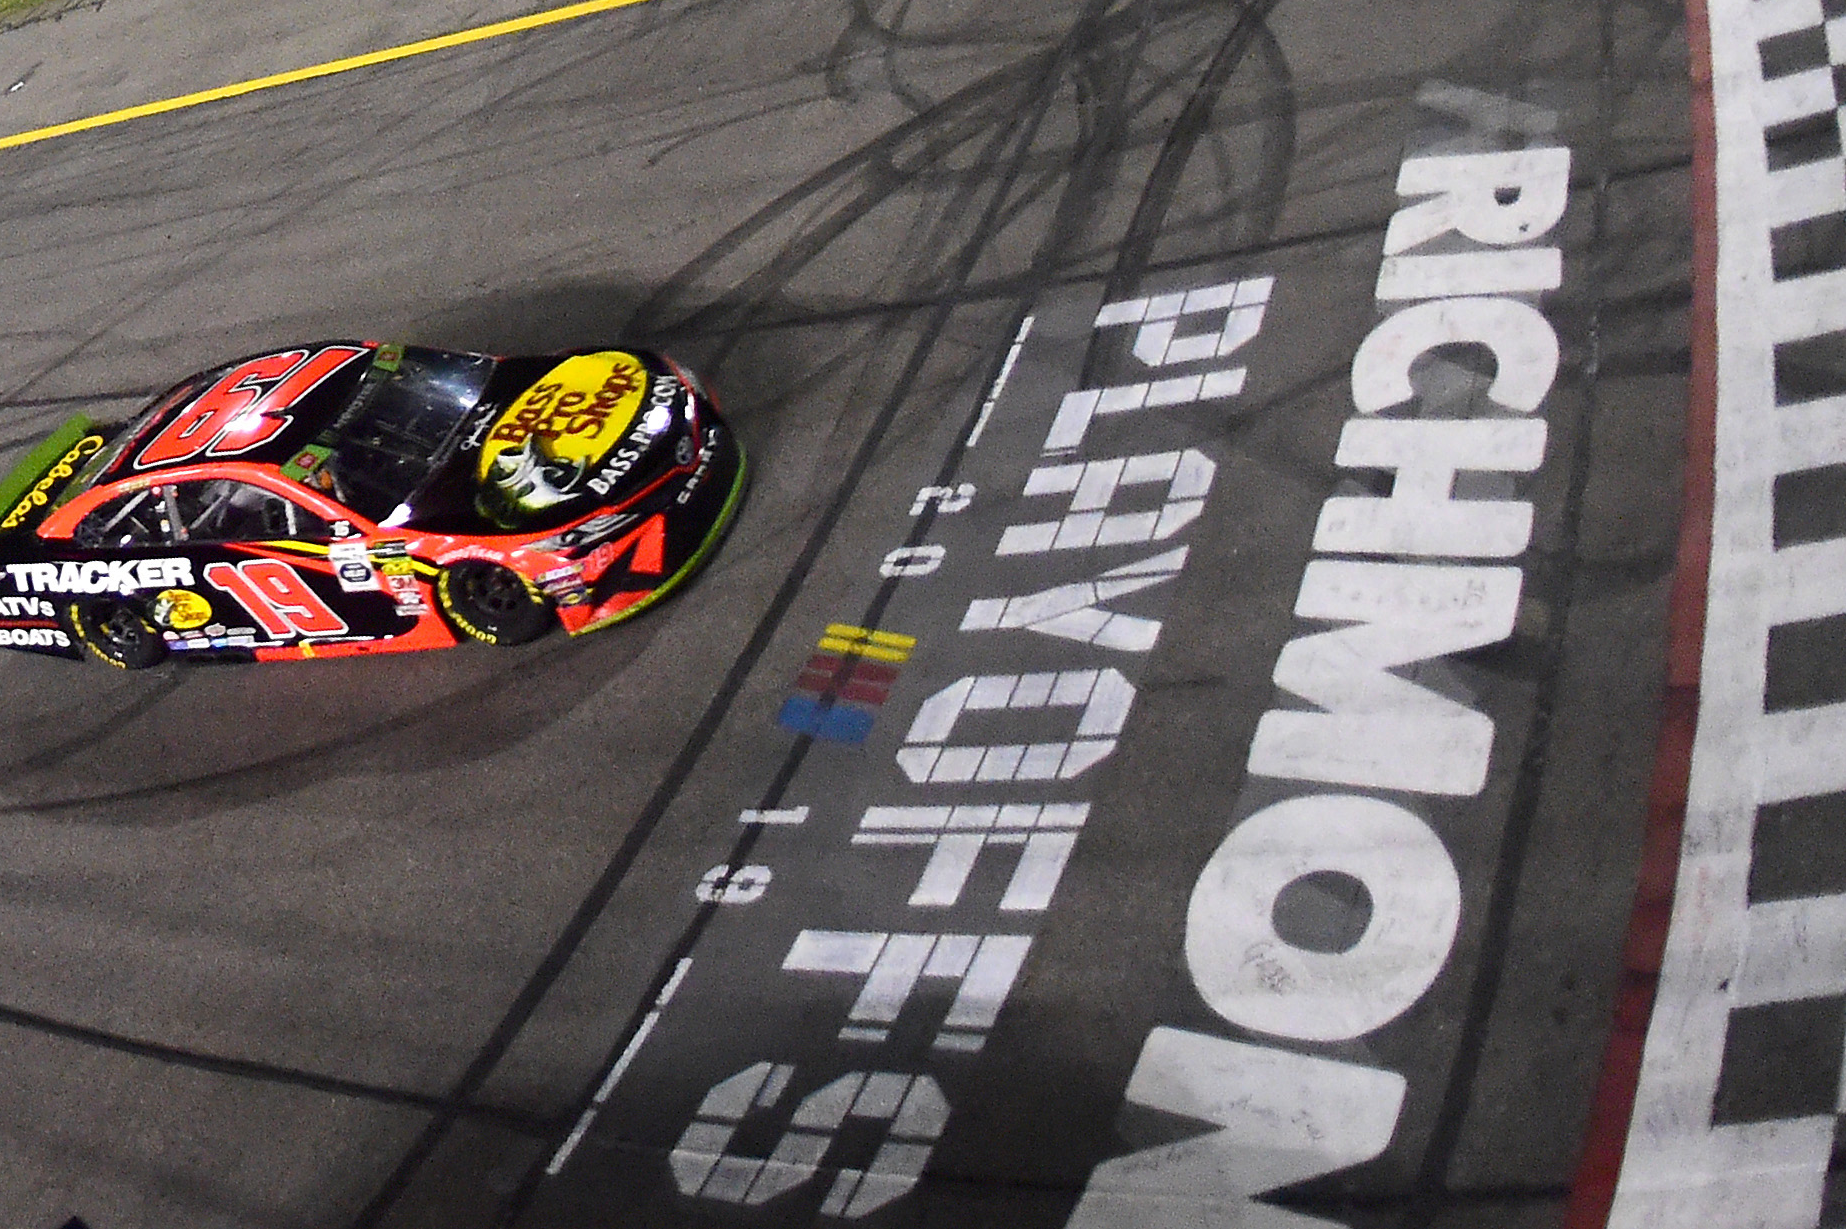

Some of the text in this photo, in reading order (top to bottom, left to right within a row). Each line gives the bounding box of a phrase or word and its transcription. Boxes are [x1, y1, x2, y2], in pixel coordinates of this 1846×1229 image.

[133, 345, 371, 470] 19
[489, 382, 563, 444] Bass
[533, 391, 587, 441] Pro
[565, 362, 642, 439] Shops
[1, 434, 104, 529] Cabela's
[6, 556, 196, 595] TRACKER
[879, 481, 978, 579] 20
[204, 557, 349, 640] 19
[668, 276, 1276, 1219] PLAYOFFS
